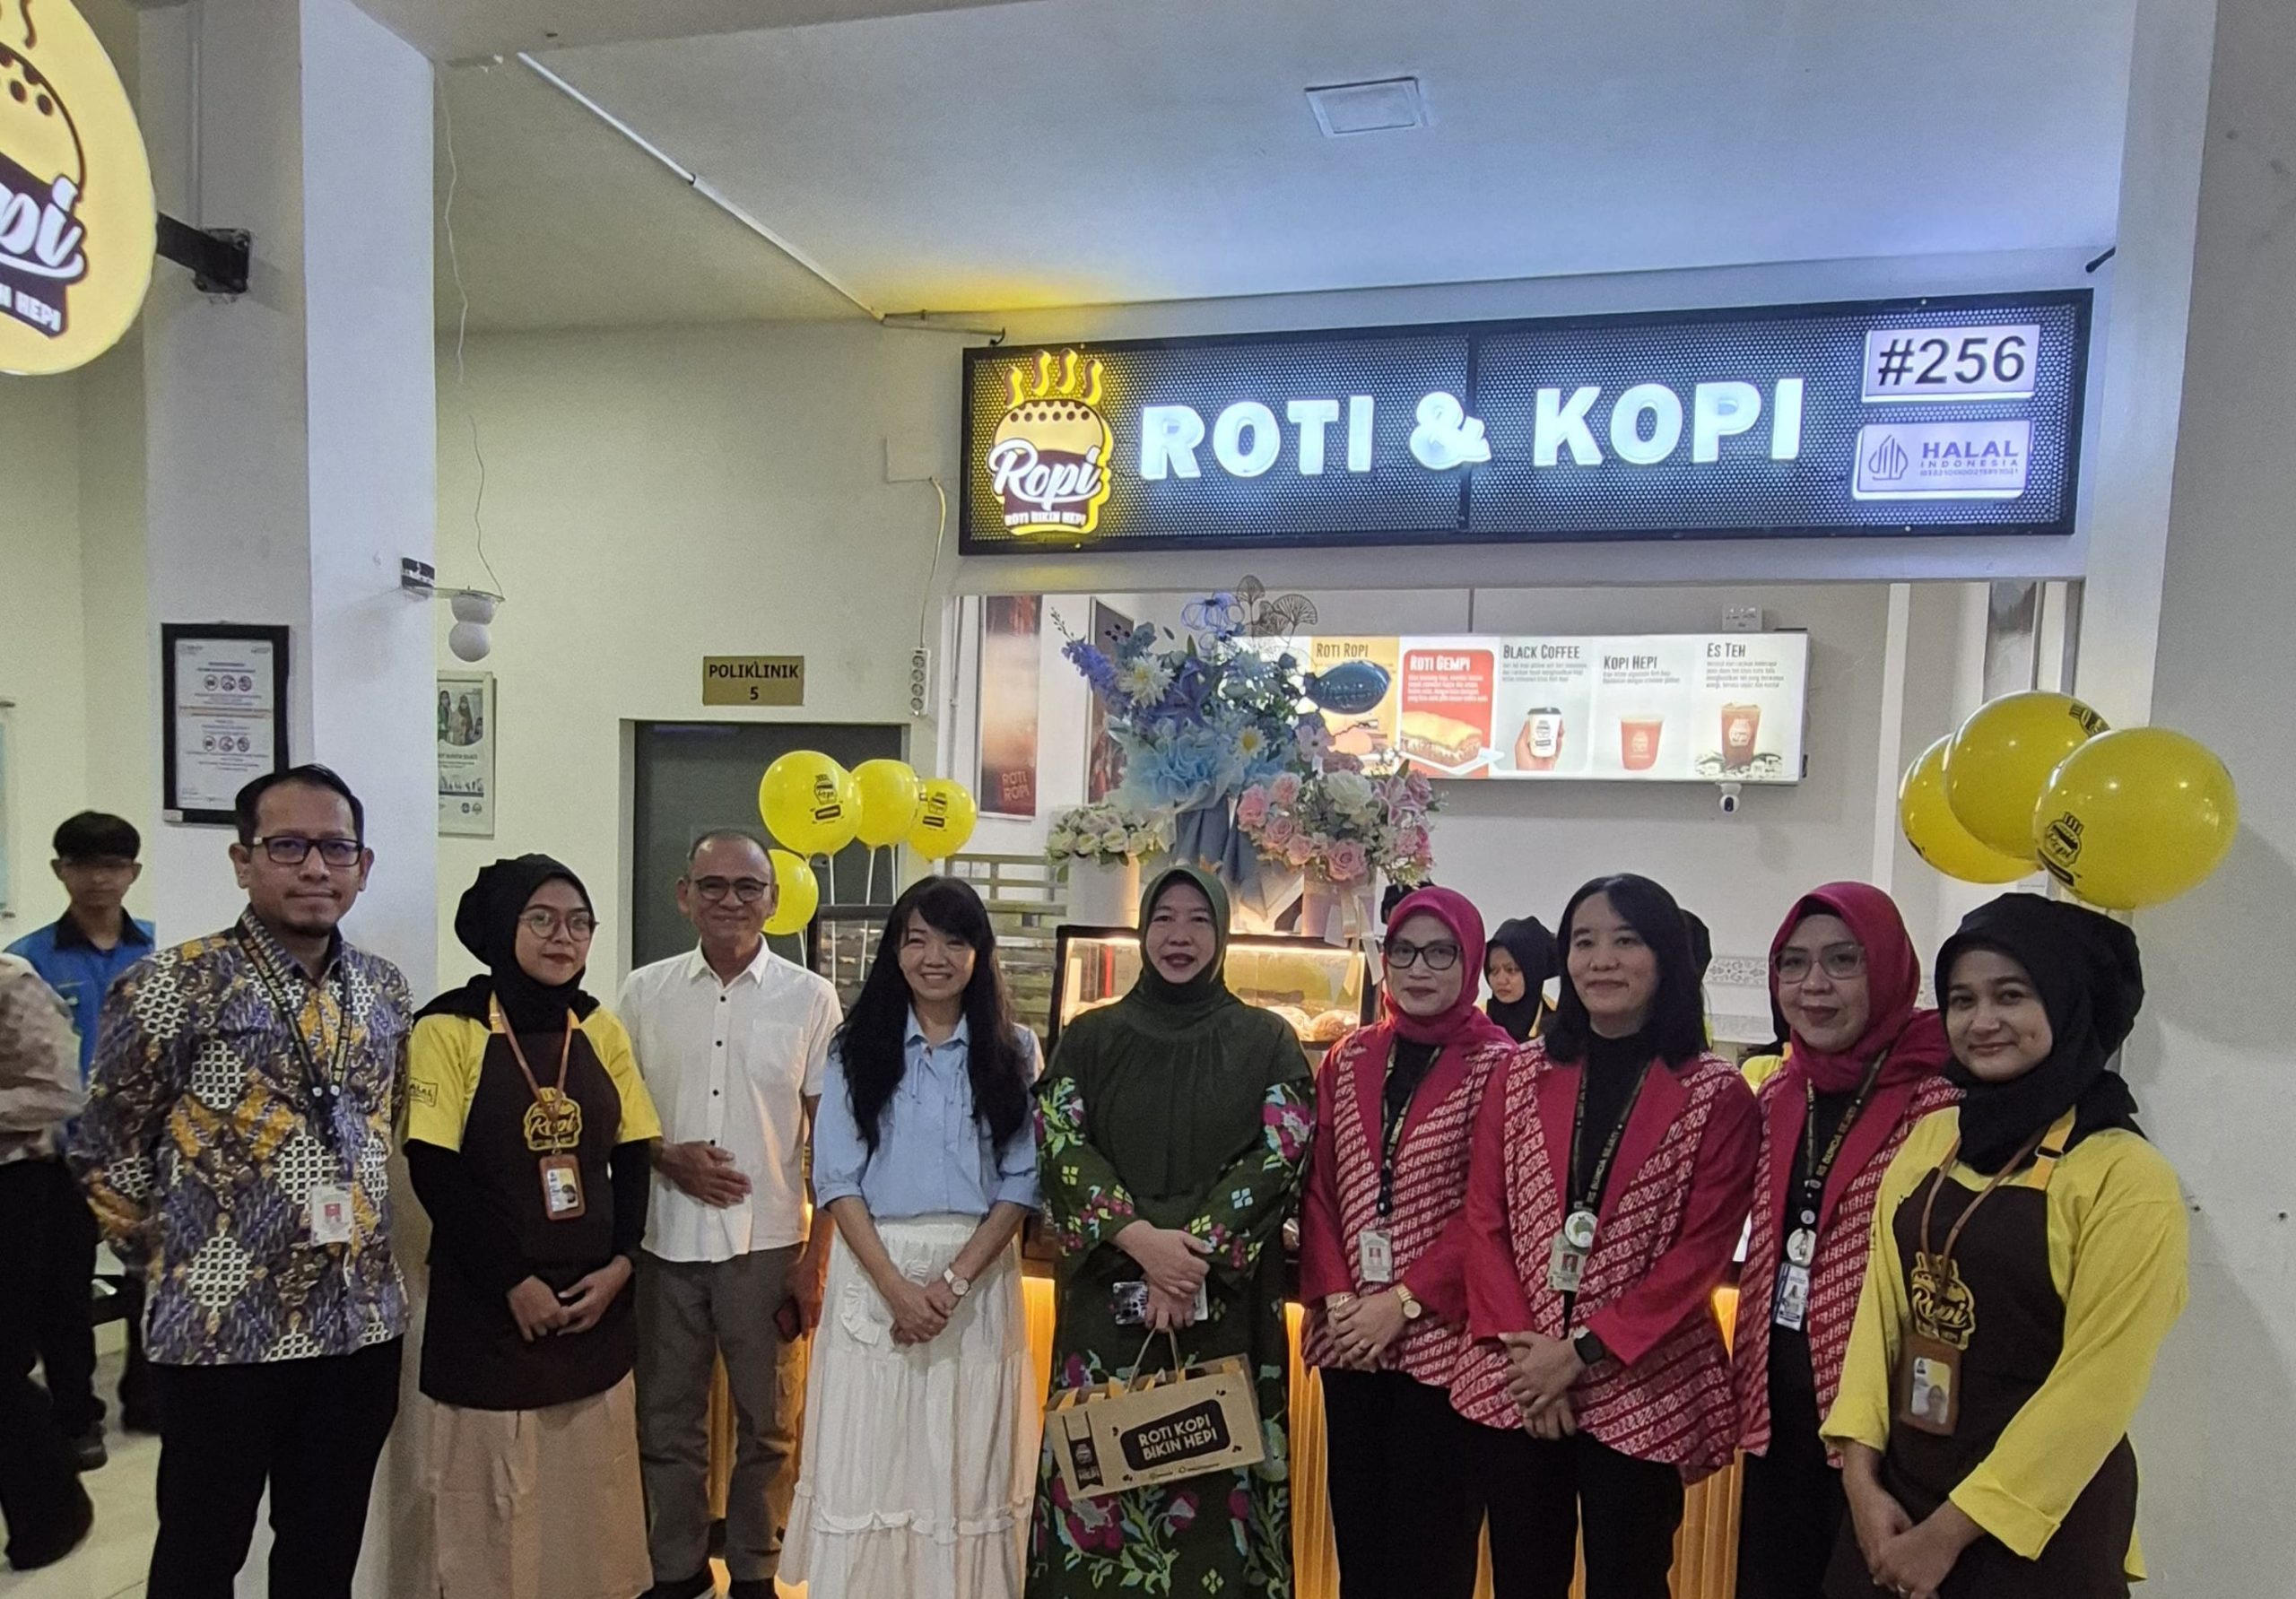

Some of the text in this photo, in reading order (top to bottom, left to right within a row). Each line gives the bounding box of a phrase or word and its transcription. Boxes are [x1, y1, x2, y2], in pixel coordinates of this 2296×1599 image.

[1876, 335, 2027, 387] #256
[1139, 378, 1805, 482] ROTI & KOPI
[1920, 459, 2019, 468] INDONESIA
[1922, 440, 2020, 459] HALAL
[988, 439, 1102, 512] Ropi
[709, 664, 799, 678] POLIKLINIK
[750, 686, 759, 700] 5
[1138, 1412, 1211, 1447] ROTI KOPI
[1142, 1427, 1218, 1461] BIKIN HEPI
